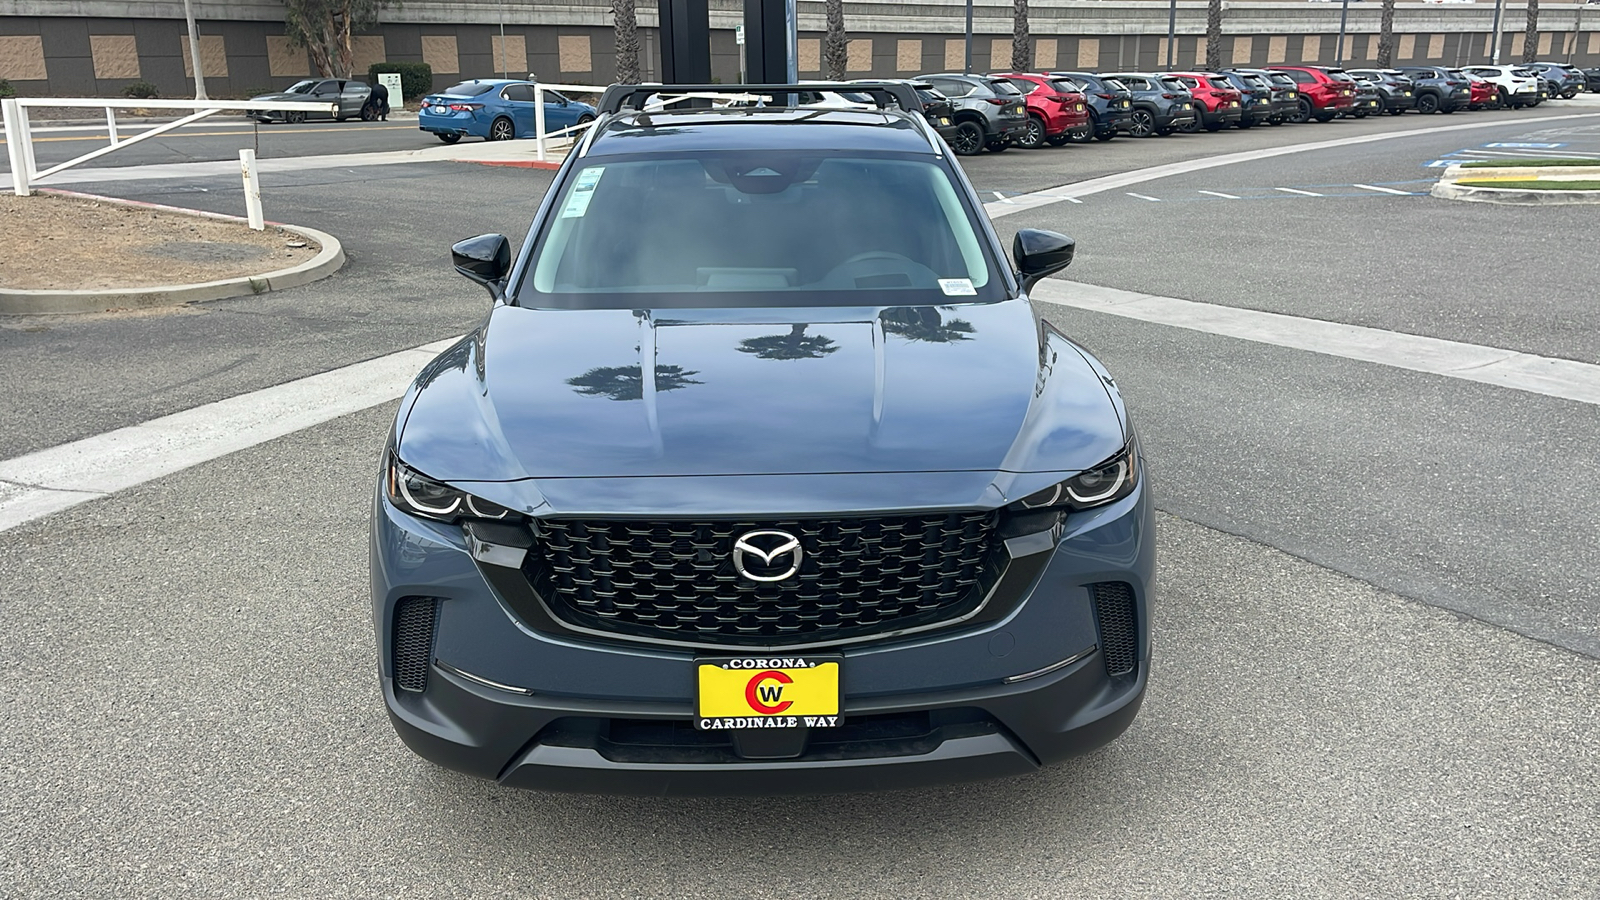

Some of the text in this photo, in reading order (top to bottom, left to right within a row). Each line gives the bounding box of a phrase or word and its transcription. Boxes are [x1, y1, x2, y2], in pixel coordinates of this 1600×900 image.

[730, 658, 807, 669] CORONA
[759, 685, 784, 702] W
[700, 716, 838, 730] CARDINALE WAY
